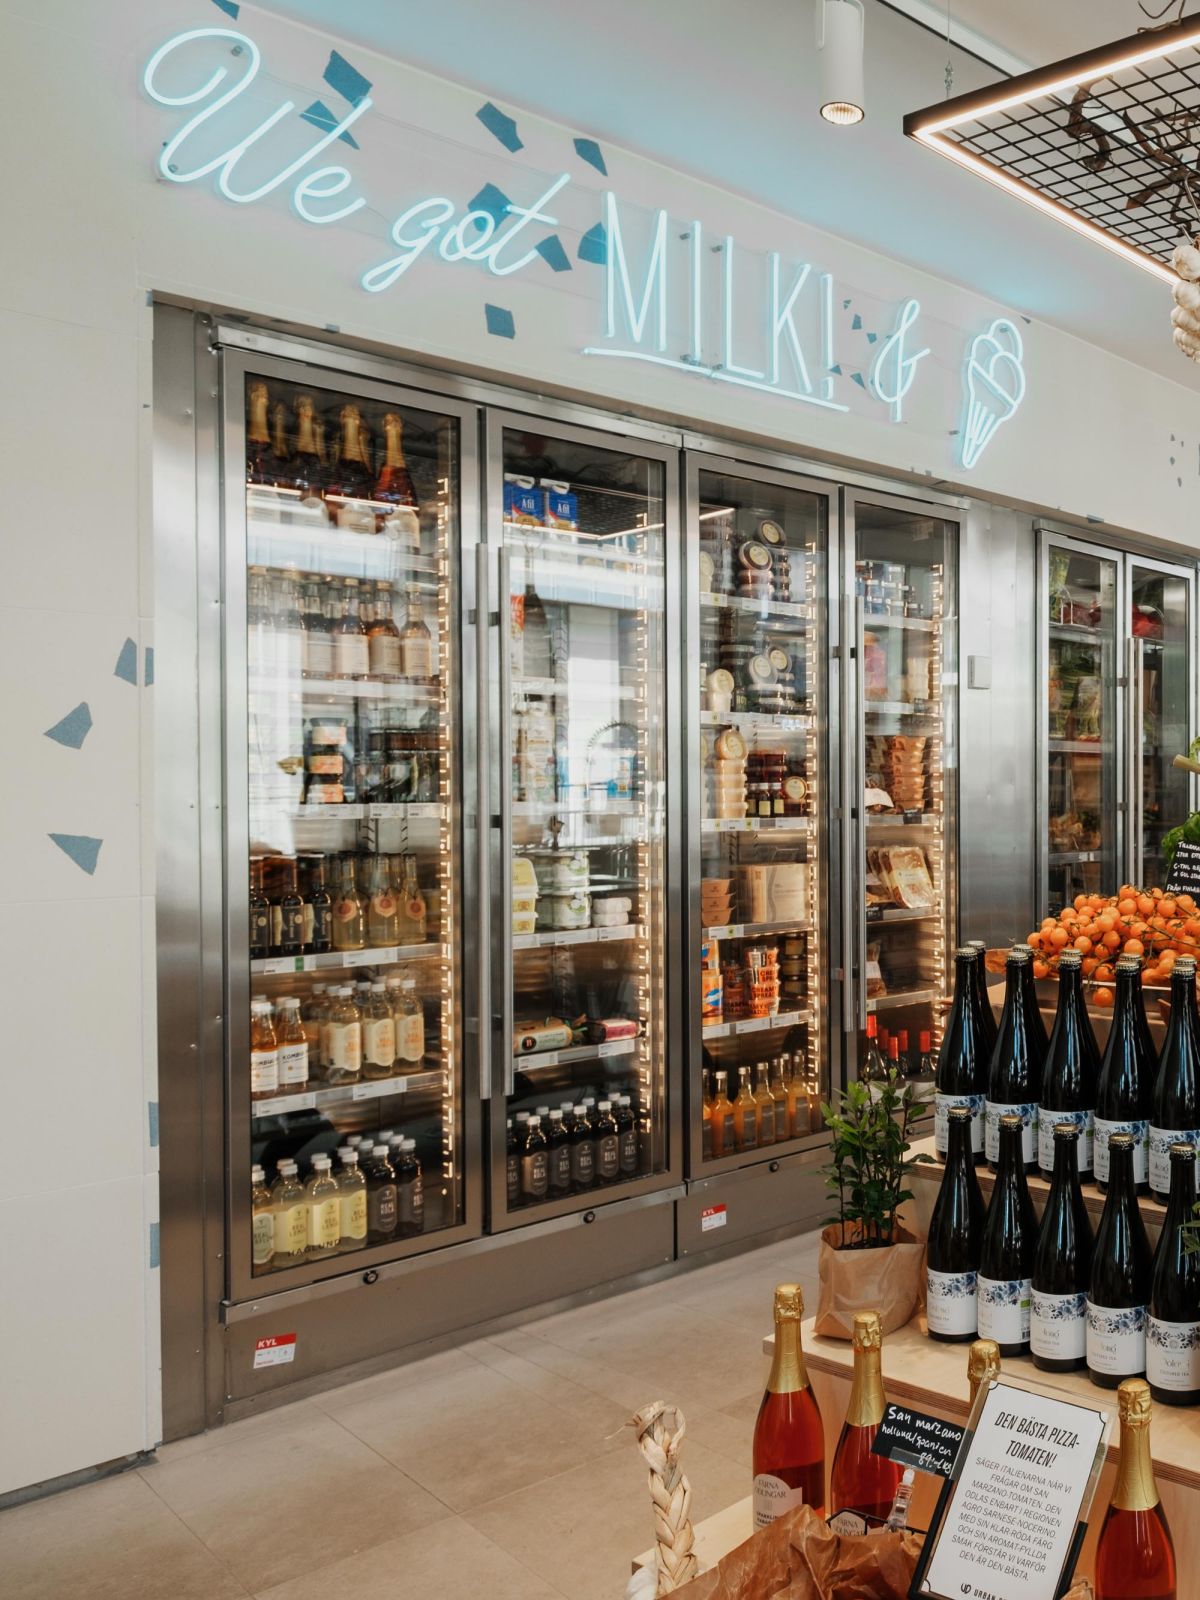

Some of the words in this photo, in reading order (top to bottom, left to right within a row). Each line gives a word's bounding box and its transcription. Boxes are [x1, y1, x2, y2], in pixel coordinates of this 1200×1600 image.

[143, 28, 372, 224] We
[362, 173, 570, 294] got
[606, 192, 835, 399] MILK!
[258, 1338, 277, 1348] KYL
[888, 1406, 911, 1424] San
[994, 1411, 1018, 1430] DEN
[1016, 1417, 1049, 1440] BÄSTA
[1047, 1427, 1080, 1448] PIZZA-
[1006, 1440, 1057, 1468] TOMATEN!
[976, 1457, 1000, 1470] SÄGER
[1000, 1465, 1046, 1484] ITALIENARNA
[1047, 1479, 1063, 1491] NÄR
[1065, 1484, 1072, 1494] VI
[991, 1474, 1019, 1489] FRÅGAR
[1020, 1483, 1033, 1493] OM
[1034, 1488, 1049, 1499] SAN
[962, 1501, 982, 1514] AGRO
[965, 1490, 989, 1504] ODLAS
[990, 1498, 1019, 1513] ENBART
[1024, 1510, 1062, 1527] REGIONEN
[1045, 1504, 1062, 1515] DEN
[958, 1524, 973, 1535] OCH
[974, 1530, 987, 1540] SIN
[959, 1512, 976, 1524] MED
[976, 1519, 990, 1528] SIN
[1033, 1537, 1054, 1550] FÄRG
[952, 1535, 973, 1548] SMAK
[974, 1542, 1008, 1559] FÖRSTÅR
[1009, 1554, 1016, 1563] VI
[1017, 1557, 1046, 1573] VARFÖR
[959, 1550, 975, 1562] DEN
[987, 1559, 1003, 1571] DEN
